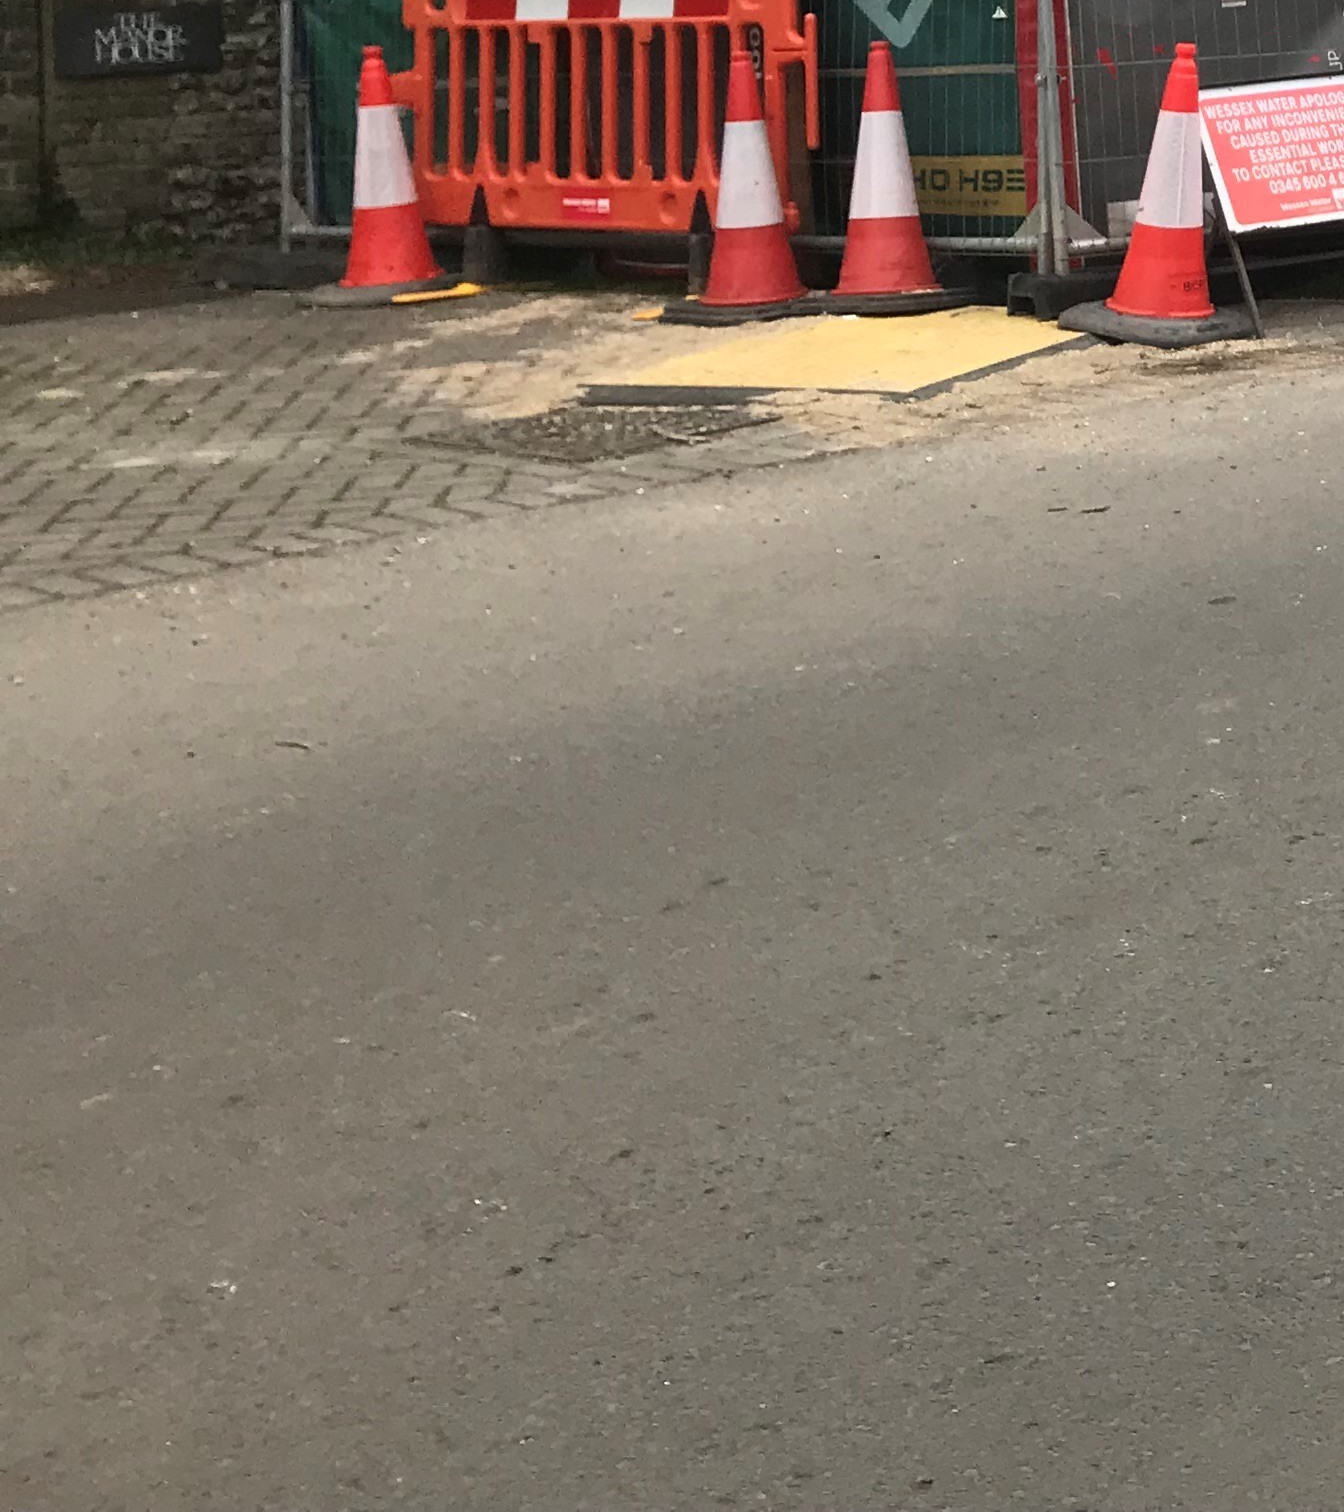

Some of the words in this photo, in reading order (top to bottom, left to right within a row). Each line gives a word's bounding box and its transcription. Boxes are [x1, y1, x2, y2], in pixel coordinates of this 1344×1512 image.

[1204, 100, 1256, 120] WESSEX
[1256, 95, 1297, 114] WATER
[1216, 119, 1241, 135] FOR
[1244, 115, 1269, 132] ANY
[1230, 131, 1280, 150] CAUSED
[1282, 125, 1330, 144] DURING
[1249, 143, 1318, 164] ESSENTIAL
[1232, 167, 1250, 183] TO
[1252, 160, 1308, 180] CONTACT
[1269, 177, 1301, 195] 0345
[1303, 175, 1327, 190] 600
[1328, 172, 1337, 185] 4
